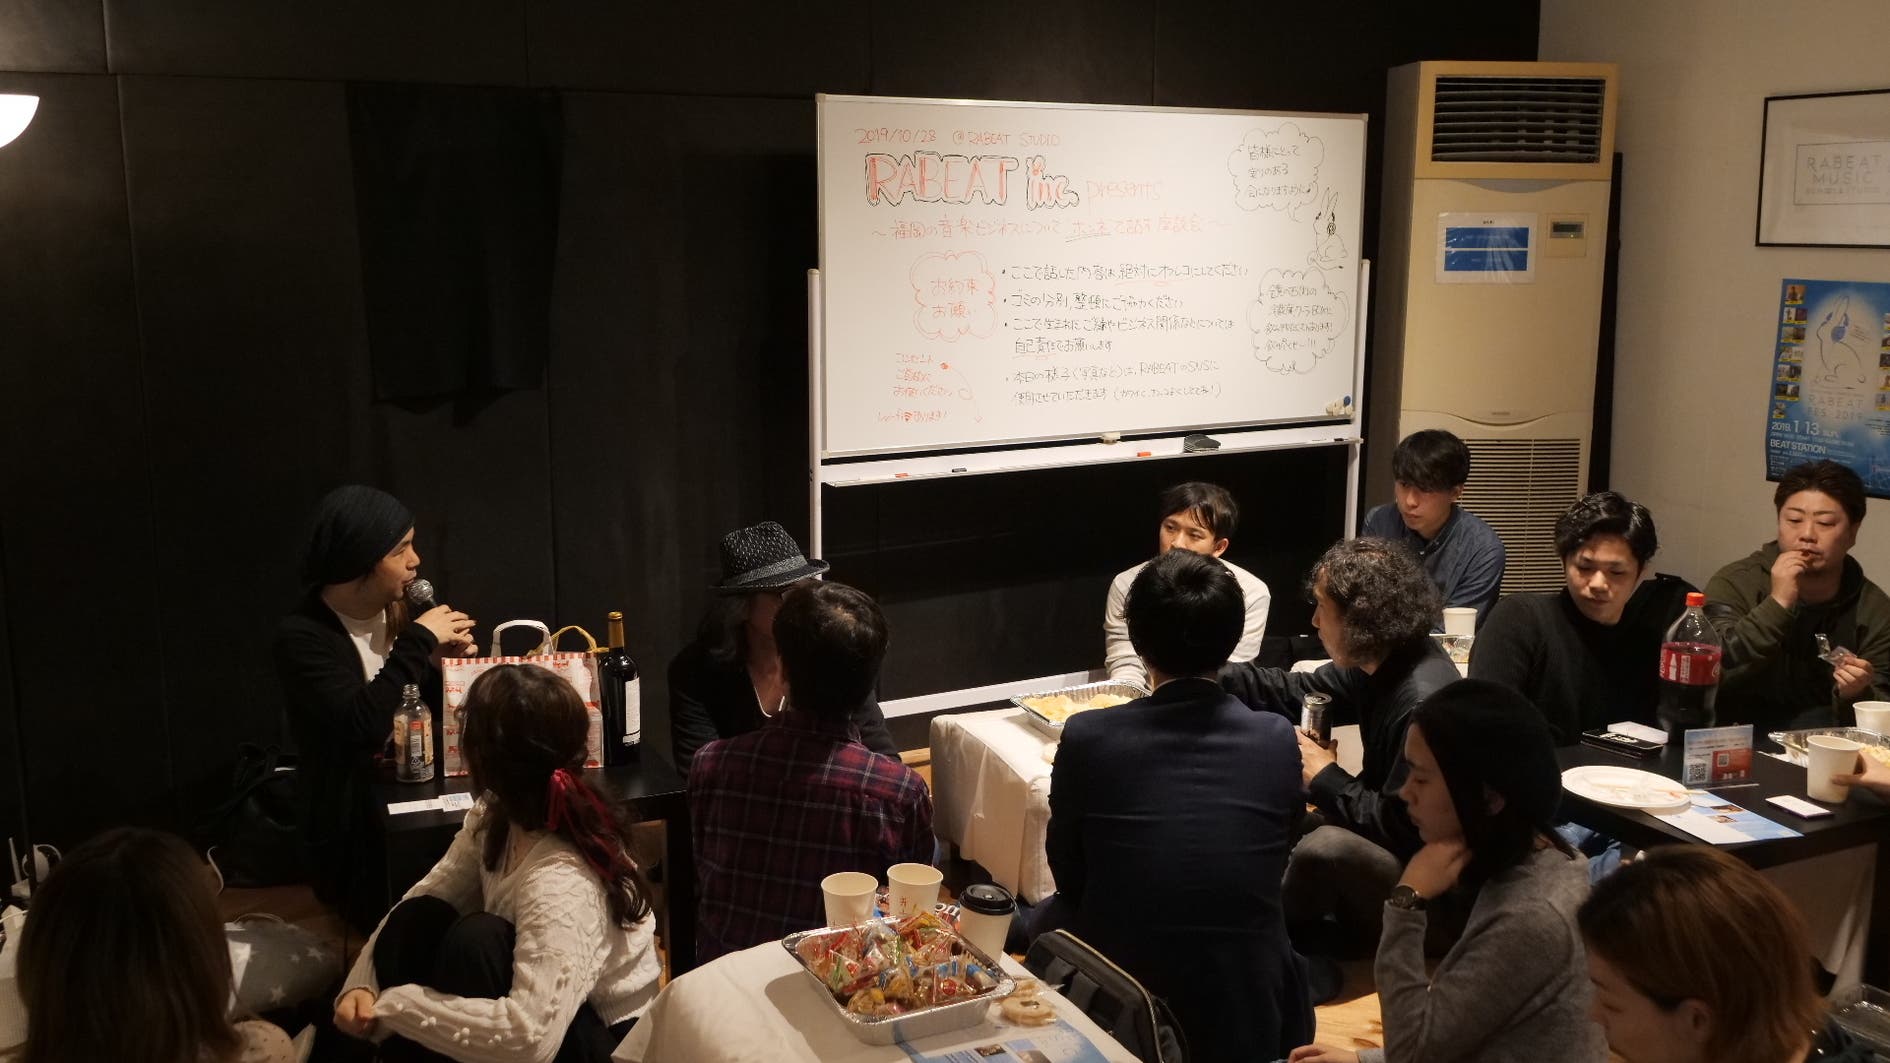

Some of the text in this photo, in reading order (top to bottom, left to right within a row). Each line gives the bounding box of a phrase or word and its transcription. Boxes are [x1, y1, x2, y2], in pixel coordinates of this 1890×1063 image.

[1018, 131, 1061, 148] STUDIO
[1806, 154, 1882, 172] RABEAT
[865, 151, 1019, 206] RABEAT
[1812, 171, 1873, 185] MUSIC
